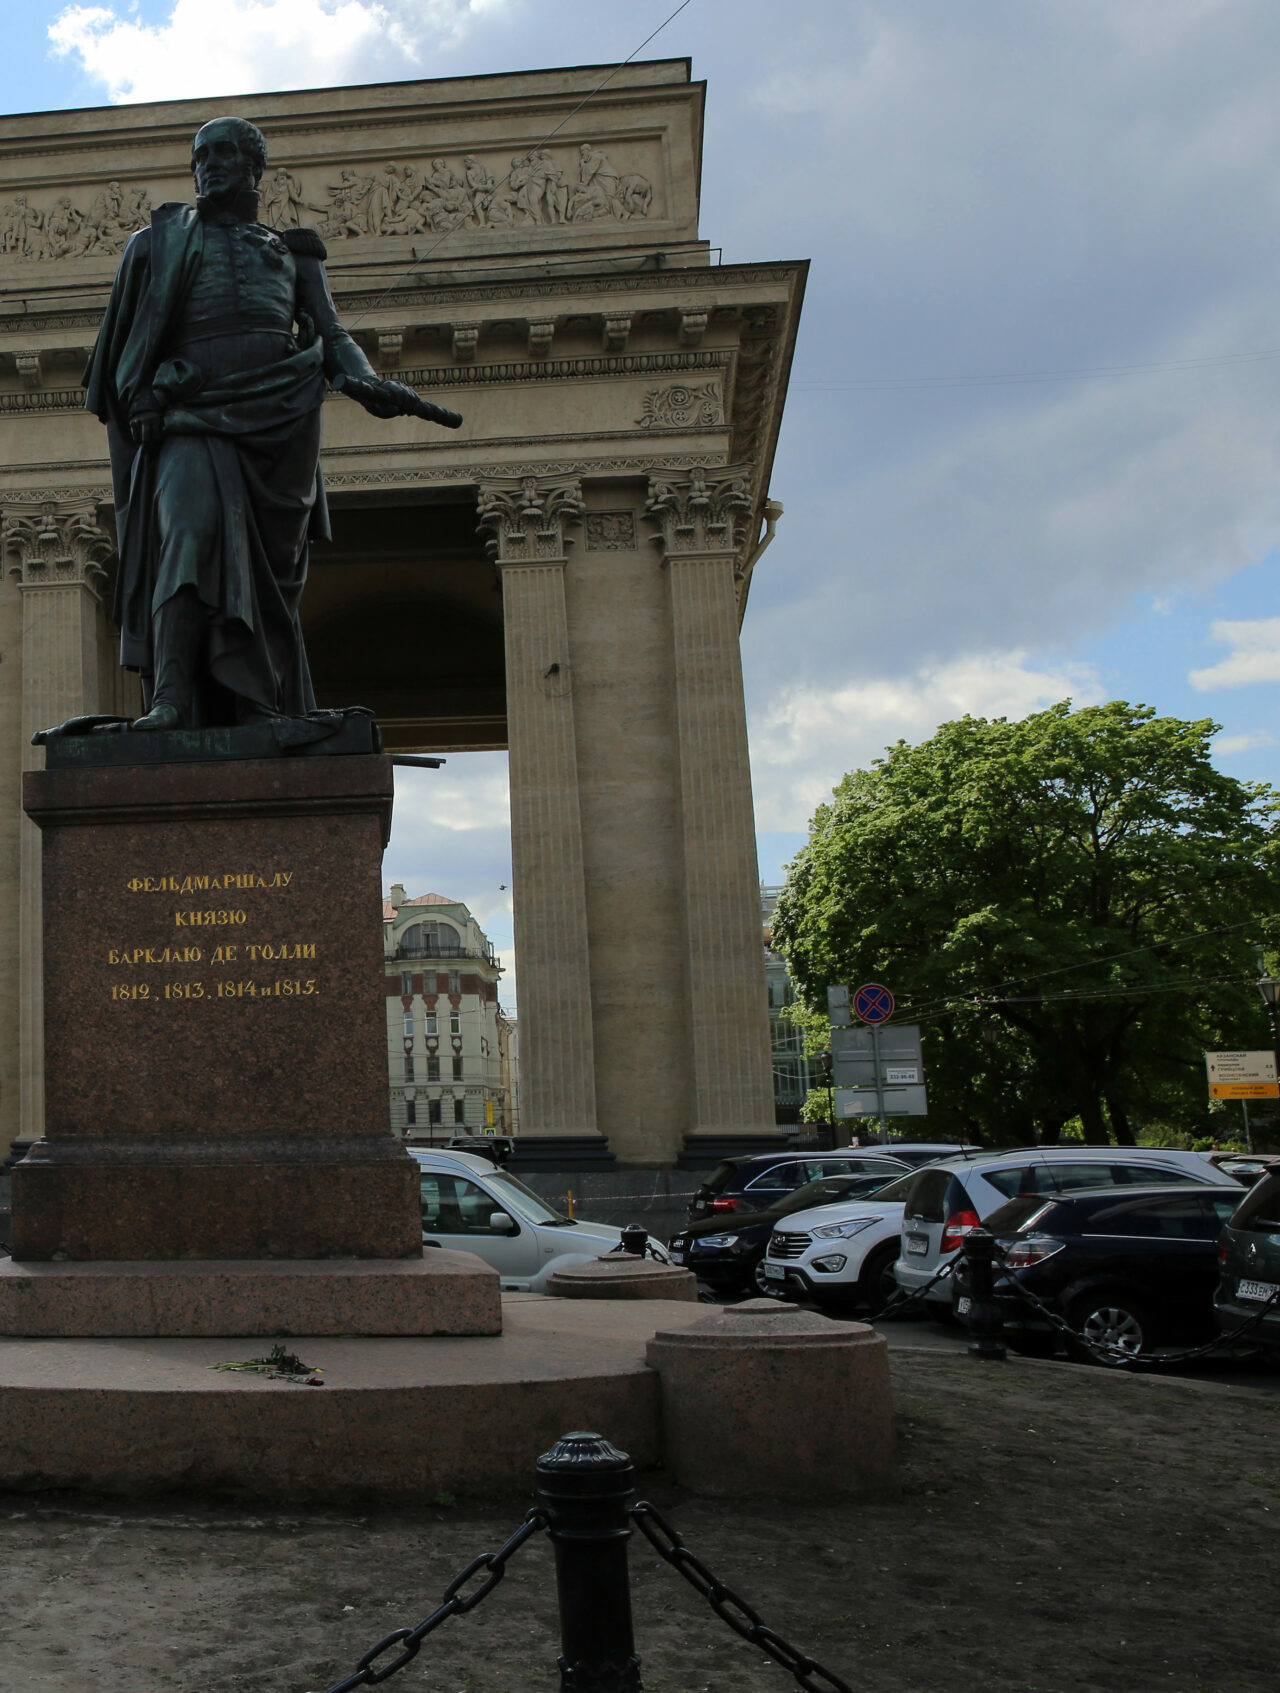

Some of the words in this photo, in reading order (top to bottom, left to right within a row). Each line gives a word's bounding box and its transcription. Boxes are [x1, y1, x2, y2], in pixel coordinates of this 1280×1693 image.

[126, 871, 293, 894] ФЕЛЬДМАРШАЛУ
[175, 909, 247, 927] КНЯЗЮ
[108, 946, 203, 965] БАРКЛАЮ
[210, 944, 238, 965] ДЕ
[245, 943, 317, 961] ТОЛЛИ
[217, 980, 257, 998] 1814
[261, 987, 272, 996] и
[274, 978, 320, 997] 1815.
